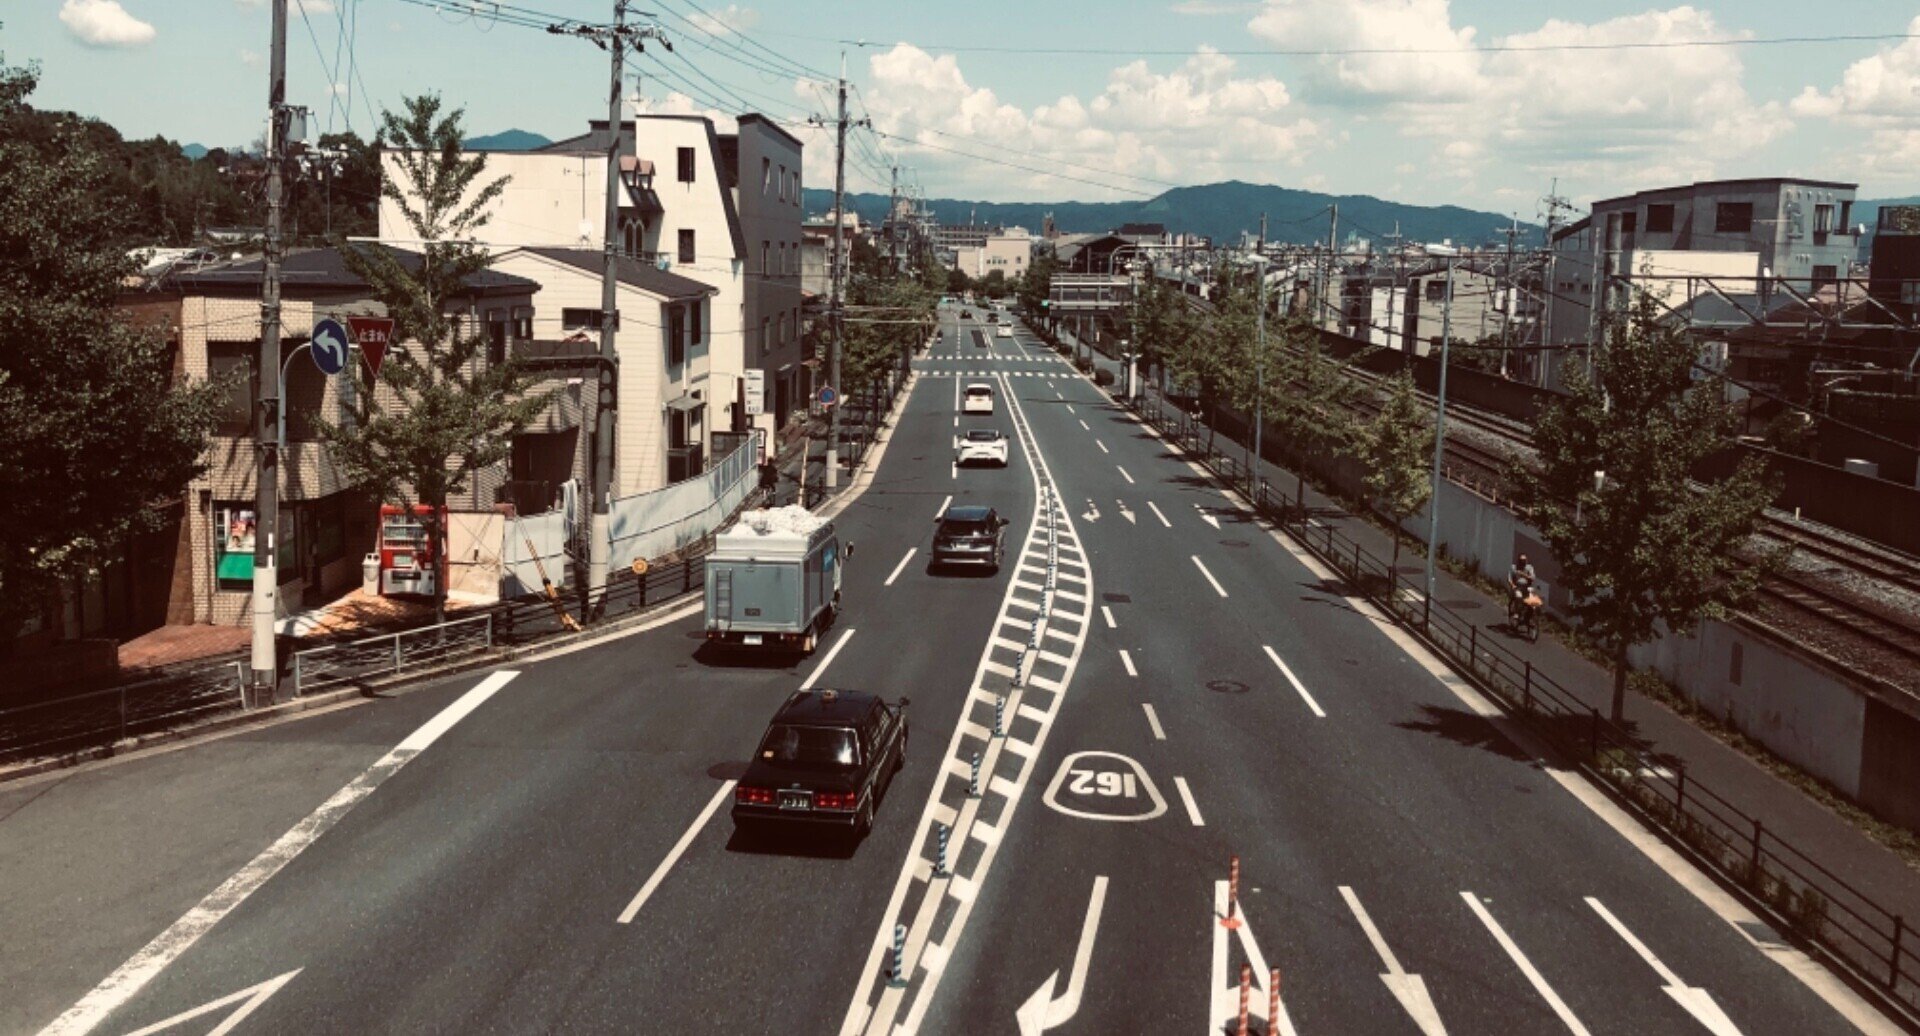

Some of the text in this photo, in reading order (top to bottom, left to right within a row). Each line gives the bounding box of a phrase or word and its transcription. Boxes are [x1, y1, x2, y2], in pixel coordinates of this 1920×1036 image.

[360, 328, 385, 342] 止まれ
[1069, 769, 1137, 798] 162
